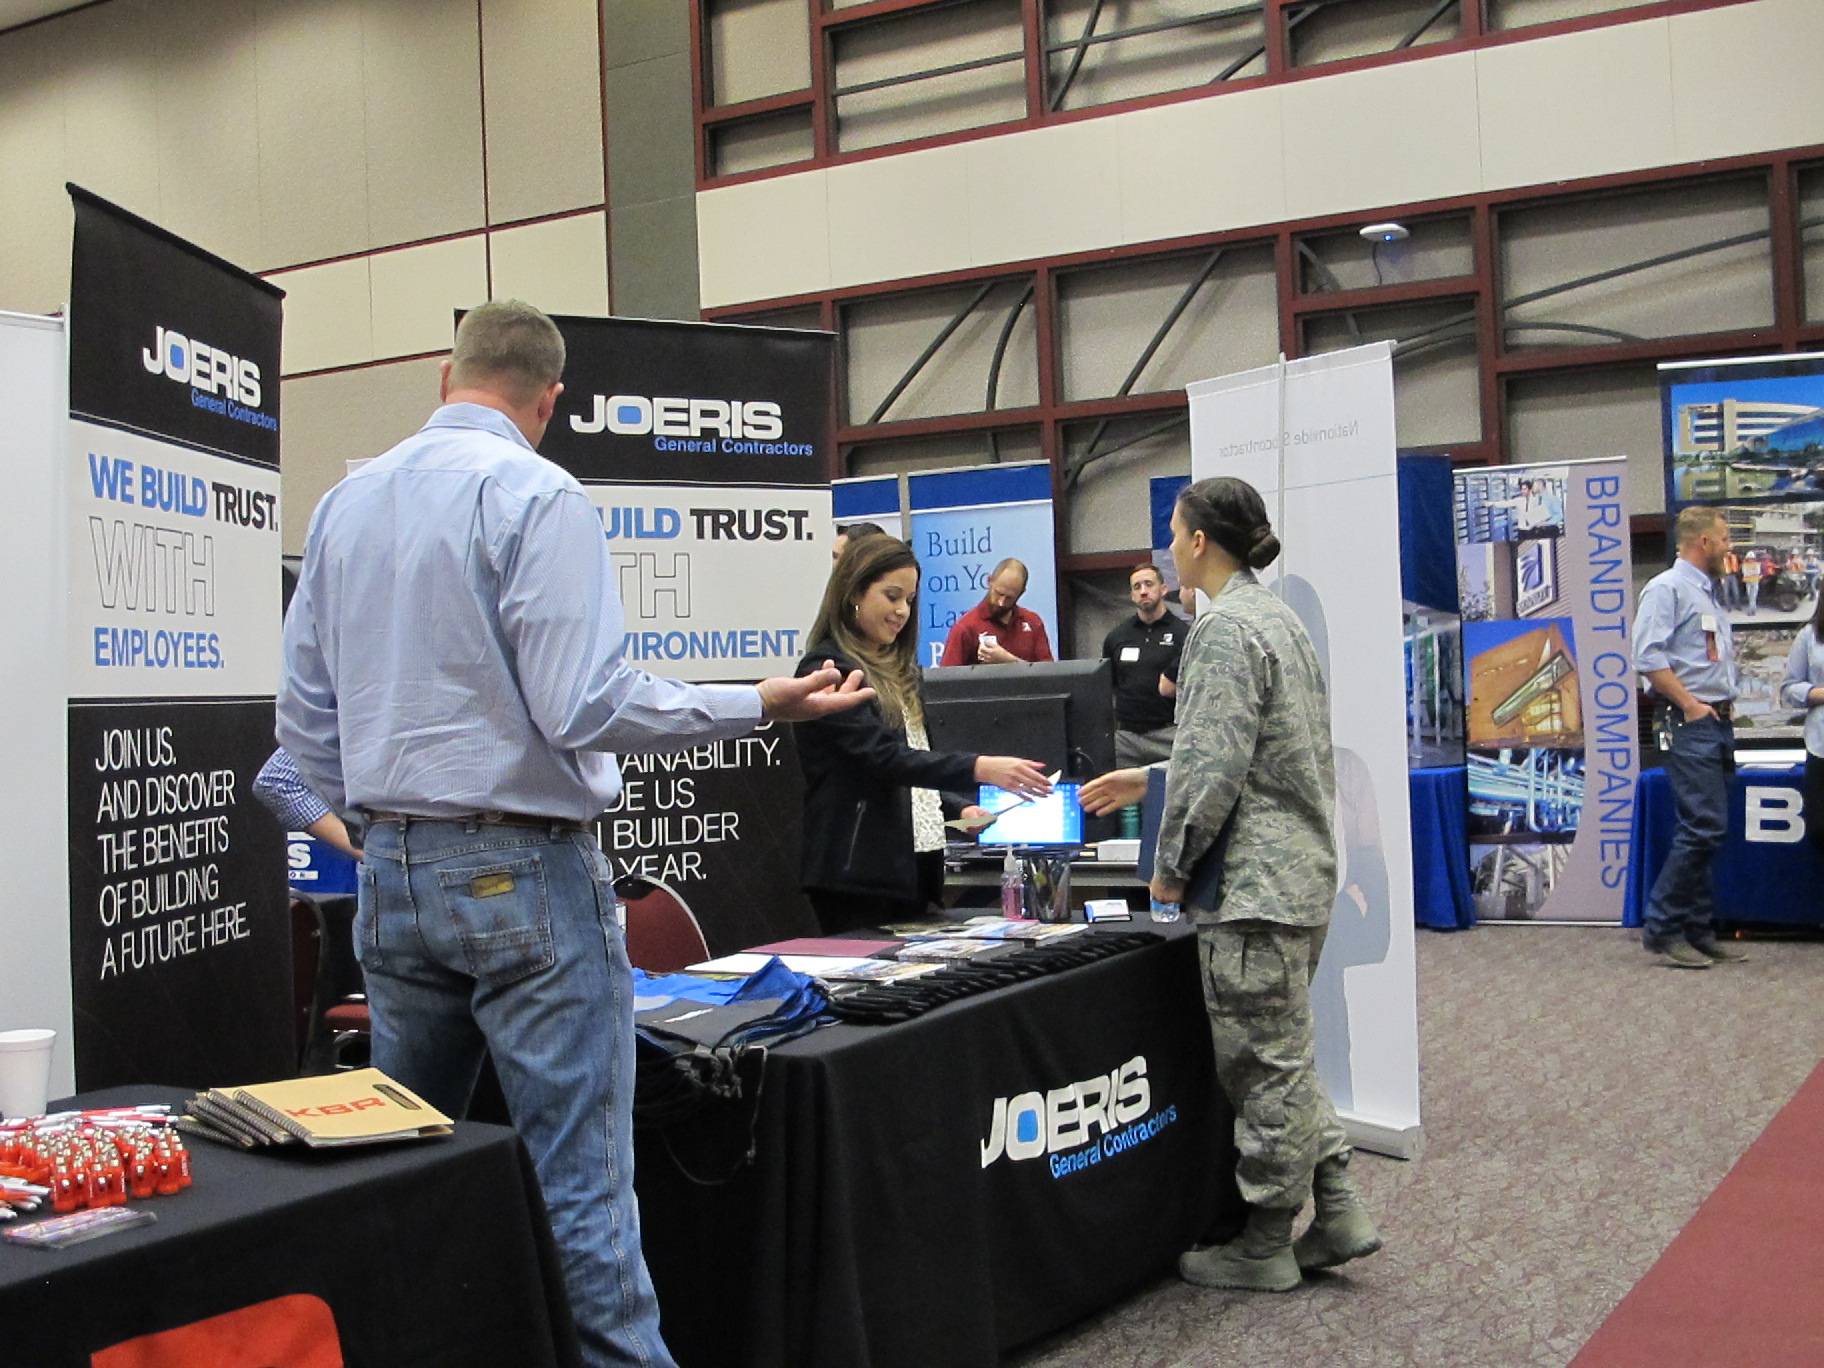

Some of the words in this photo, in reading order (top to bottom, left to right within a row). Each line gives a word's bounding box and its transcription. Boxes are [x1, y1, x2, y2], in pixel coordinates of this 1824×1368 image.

[143, 326, 260, 407] JOERIS
[191, 387, 226, 415] General
[227, 400, 277, 431] Contractors
[570, 394, 783, 440] JOERIS
[655, 436, 716, 452] General
[722, 439, 813, 456] Contractors
[88, 453, 134, 502] WE
[141, 472, 207, 517] BUILD
[212, 483, 279, 532] TRUST.
[596, 507, 681, 539] UILD
[690, 509, 813, 540] TRUST.
[928, 527, 992, 557] Build
[89, 516, 214, 616] WITH
[928, 575, 959, 592] on
[963, 564, 990, 591] Yo
[1585, 475, 1626, 638] BRANDT
[610, 552, 690, 618] TH
[930, 603, 958, 628] La
[94, 627, 224, 669] EMPLOYEES.
[623, 629, 803, 661] VIRONMENT.
[96, 728, 140, 772] JOIN
[146, 727, 176, 767] US.
[621, 737, 781, 773] AINABILITY.
[1593, 655, 1632, 889] COMPANIES
[97, 779, 140, 823] AND
[146, 770, 235, 816] DISCOVER
[655, 778, 695, 810] US
[98, 829, 138, 874] THE
[144, 816, 229, 867] BENEFITS
[614, 812, 740, 850] BUILDER
[619, 852, 707, 883] YEAR.
[100, 882, 128, 927] OF
[131, 864, 219, 919] BUILDING
[101, 938, 117, 980] A
[121, 916, 196, 973] FUTURE
[201, 902, 250, 948] HERE.
[286, 1097, 385, 1117] KBR
[980, 1055, 1151, 1168] JOERIS
[1050, 1146, 1101, 1179] General
[1104, 1104, 1177, 1158] Contractors
